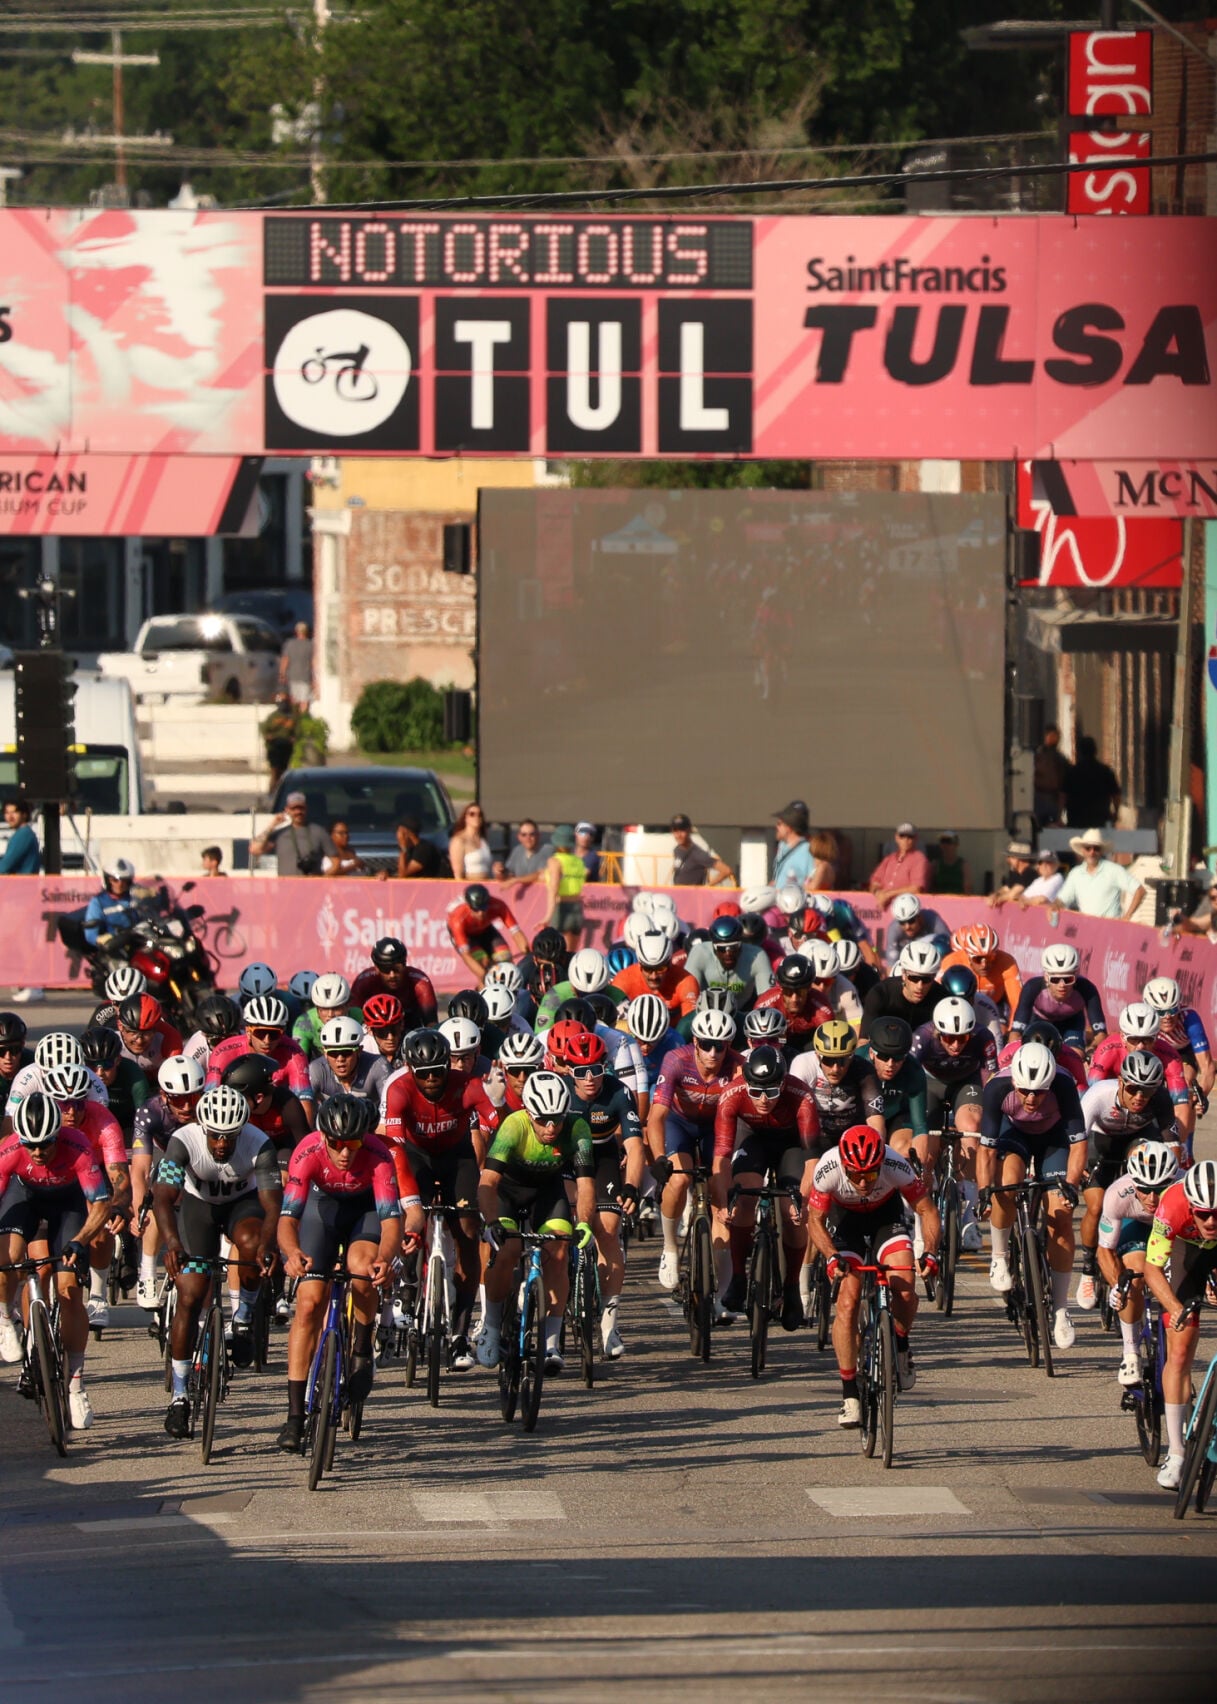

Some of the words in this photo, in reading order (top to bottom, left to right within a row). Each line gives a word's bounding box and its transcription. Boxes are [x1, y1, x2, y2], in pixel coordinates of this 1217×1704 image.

[310, 222, 708, 284] NOTORIOUS
[804, 303, 1211, 387] TULSA
[365, 563, 450, 593] SODA
[407, 951, 457, 977] ystem
